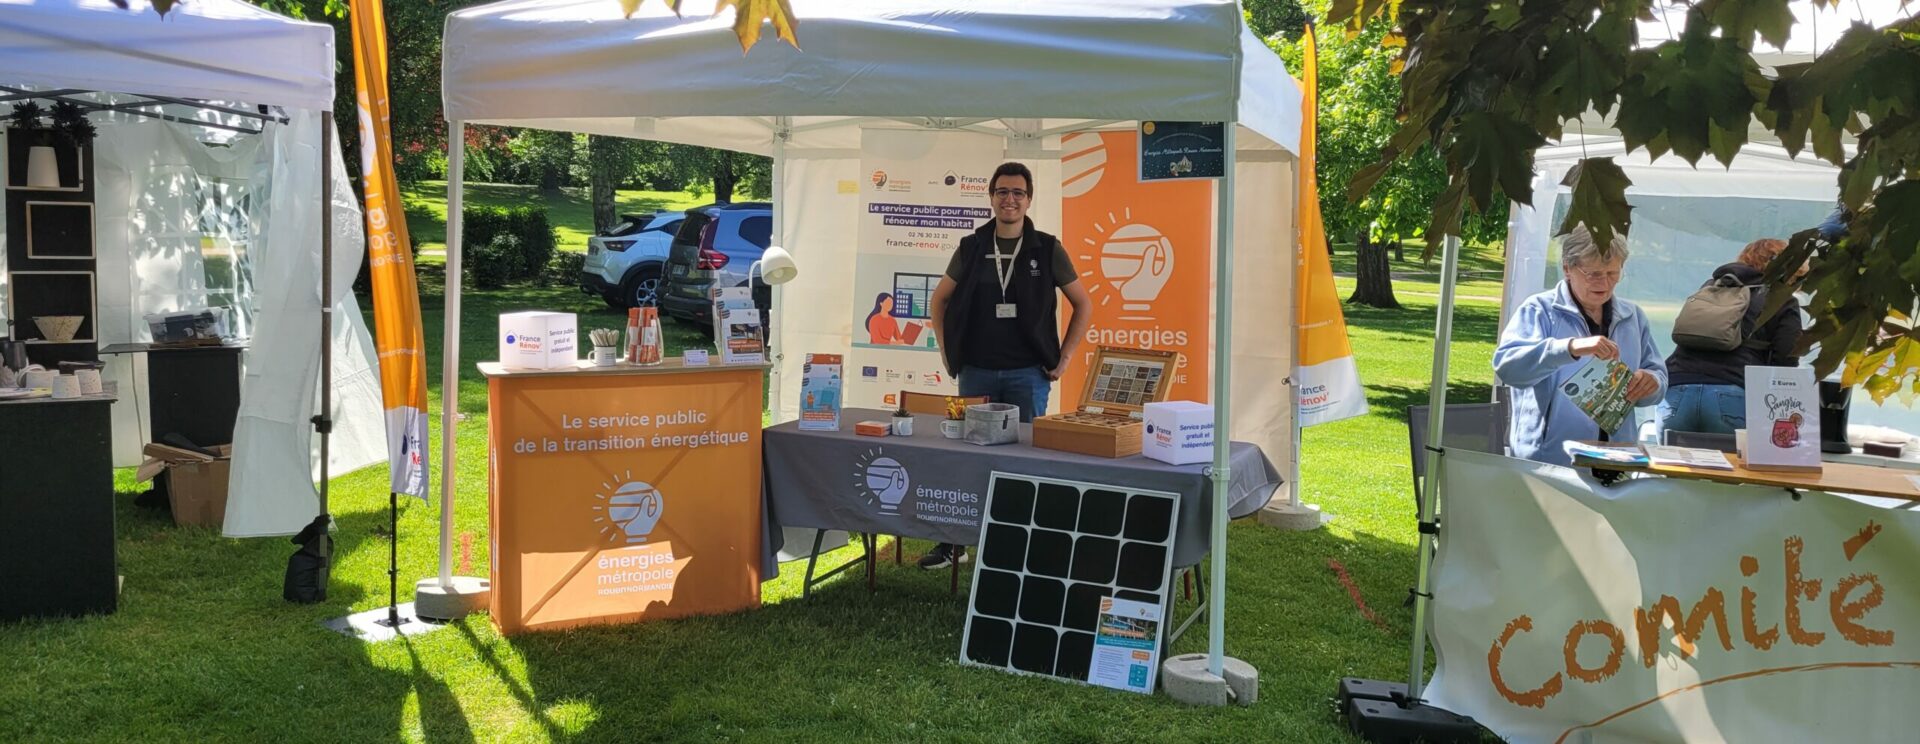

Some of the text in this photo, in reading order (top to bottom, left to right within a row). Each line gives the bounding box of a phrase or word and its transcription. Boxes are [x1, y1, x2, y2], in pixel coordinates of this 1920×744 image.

[961, 175, 987, 183] France
[869, 204, 989, 217] Le service public pour mieux
[885, 216, 918, 225] rénover
[941, 219, 972, 228] habitat
[1085, 324, 1188, 349] énergies
[1764, 394, 1806, 420] Sangria
[562, 409, 707, 429] Le service public
[1156, 426, 1171, 435] France
[513, 430, 749, 454] de la transition énergétique
[916, 485, 979, 504] énergies
[916, 501, 979, 517] métropole
[598, 551, 675, 569] énergies
[597, 567, 674, 585] métropole
